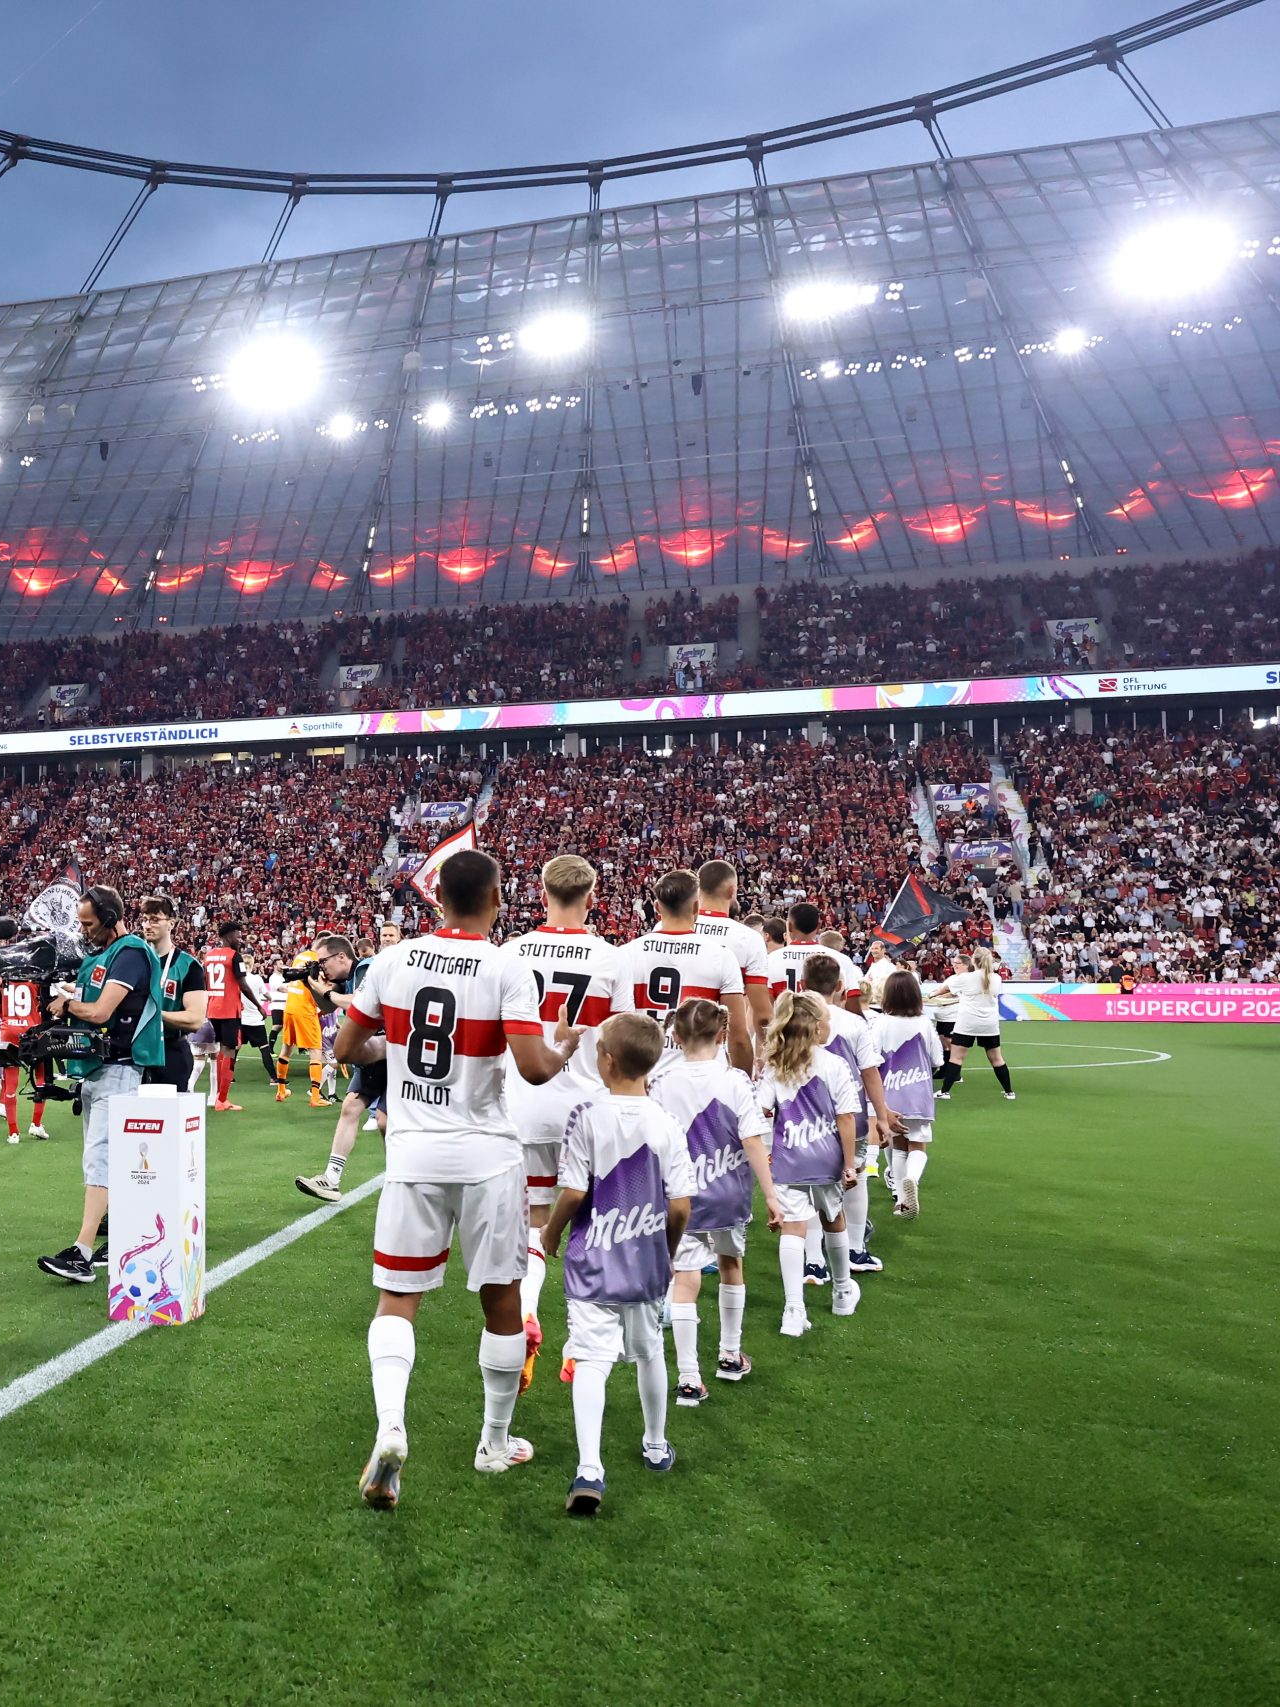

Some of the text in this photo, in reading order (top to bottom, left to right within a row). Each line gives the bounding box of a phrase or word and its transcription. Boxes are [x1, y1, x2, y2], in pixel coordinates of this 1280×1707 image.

[1123, 683, 1167, 692] STIFTUNG
[69, 727, 218, 746] SELBSTVERSTÄNDLICH
[303, 721, 343, 733] Sporthilfe
[694, 922, 729, 936] TTGART
[518, 943, 592, 960] STUTTGART
[643, 940, 702, 956] STUTTGART
[407, 949, 482, 977] STUTTGART
[206, 962, 225, 990] 12
[648, 966, 682, 1010] 9
[3, 984, 32, 1017] 19
[1116, 1000, 1237, 1017] SUPERCUP
[7, 1018, 28, 1027] TELLA
[406, 986, 457, 1080] 8
[883, 1066, 931, 1091] Milka
[401, 1080, 451, 1107] MILLOT
[126, 1122, 161, 1131] ELTEN
[782, 1114, 838, 1150] Milka
[584, 1202, 667, 1252] Milka
